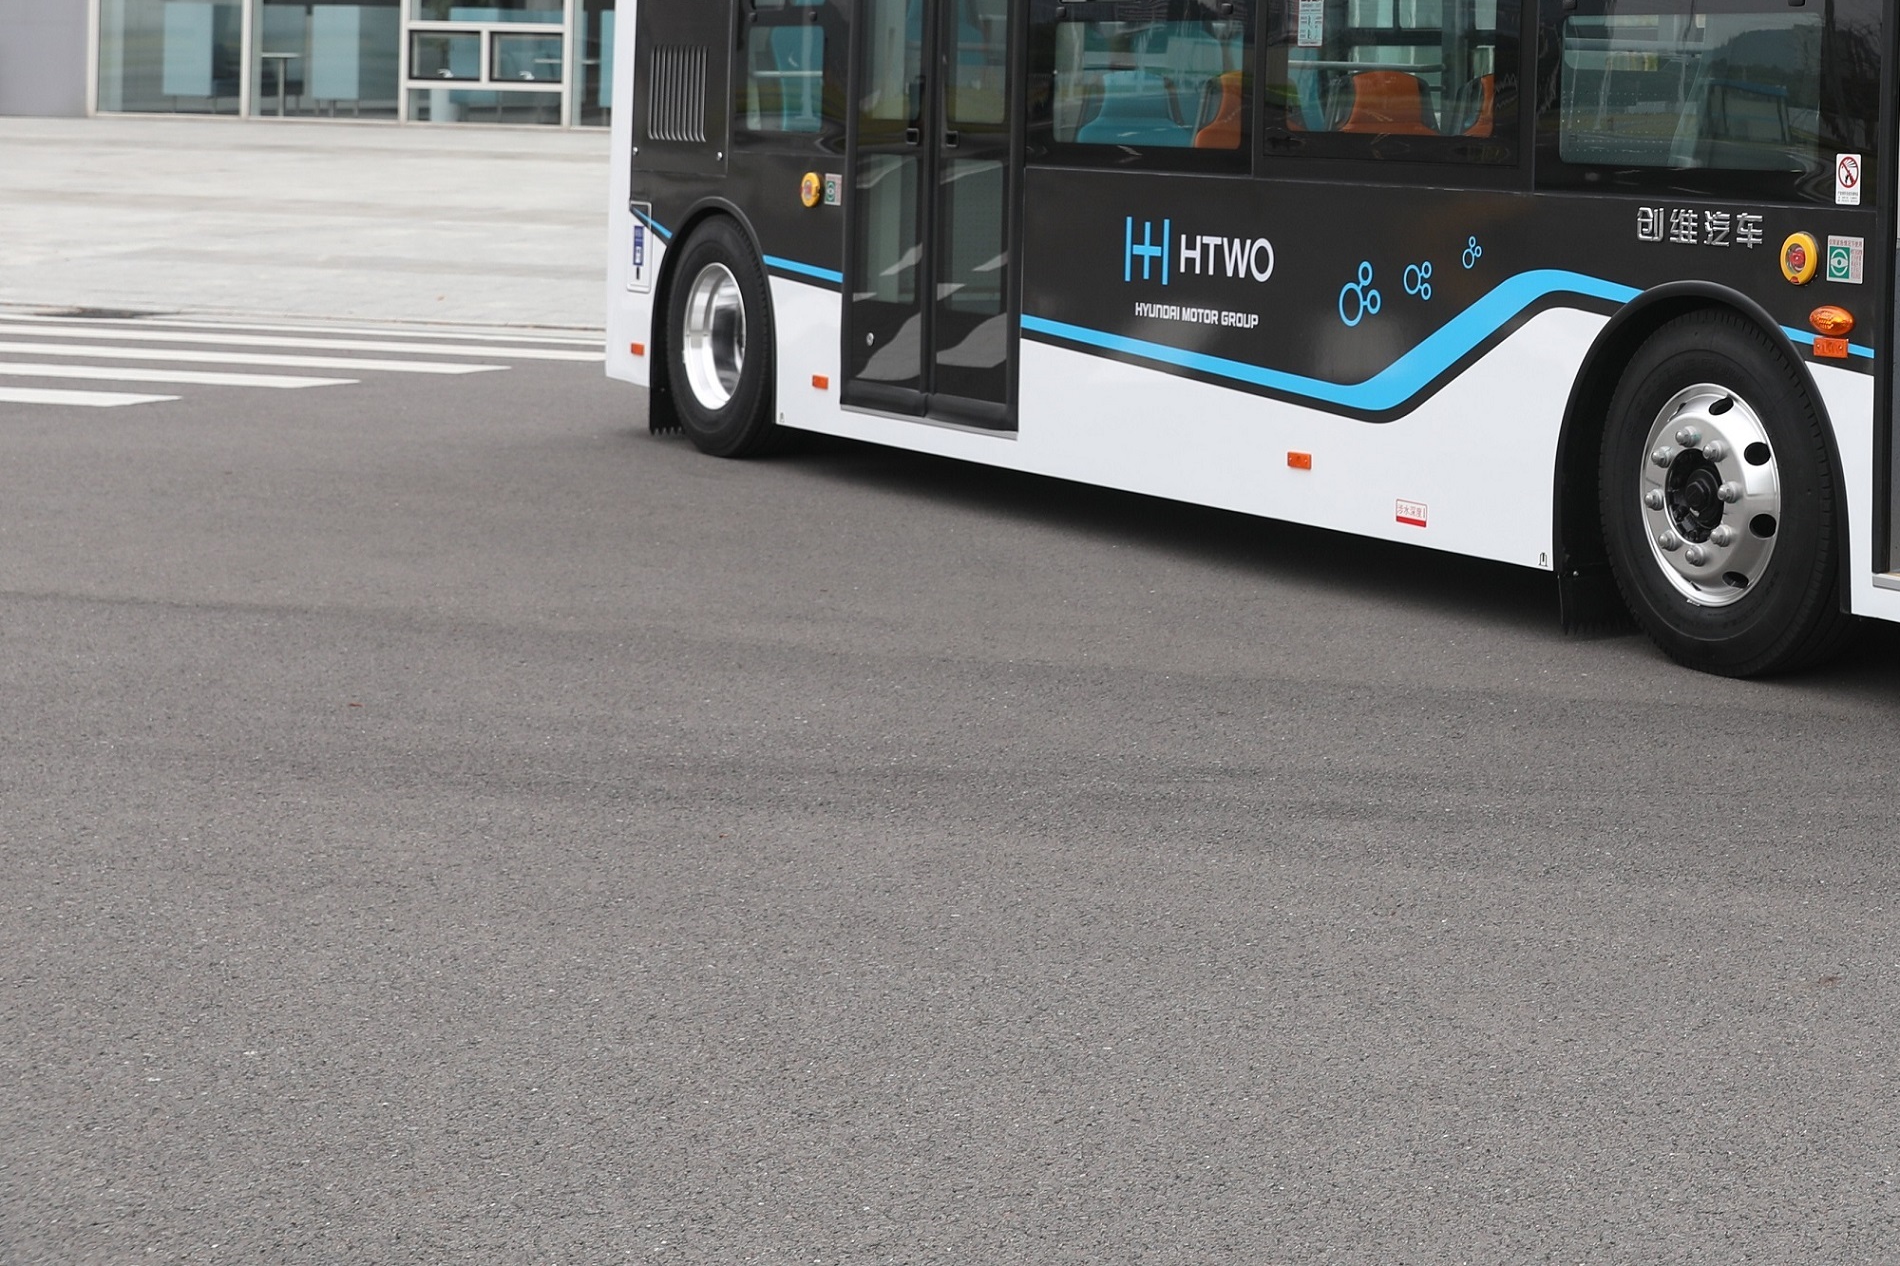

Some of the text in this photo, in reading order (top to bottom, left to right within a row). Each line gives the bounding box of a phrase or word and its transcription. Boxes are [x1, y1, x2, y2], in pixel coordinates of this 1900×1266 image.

[1636, 206, 1763, 249] 创维汽车
[1180, 234, 1275, 283] HTWO
[1135, 302, 1259, 329] HYUNDAI MOTOR GROUP
